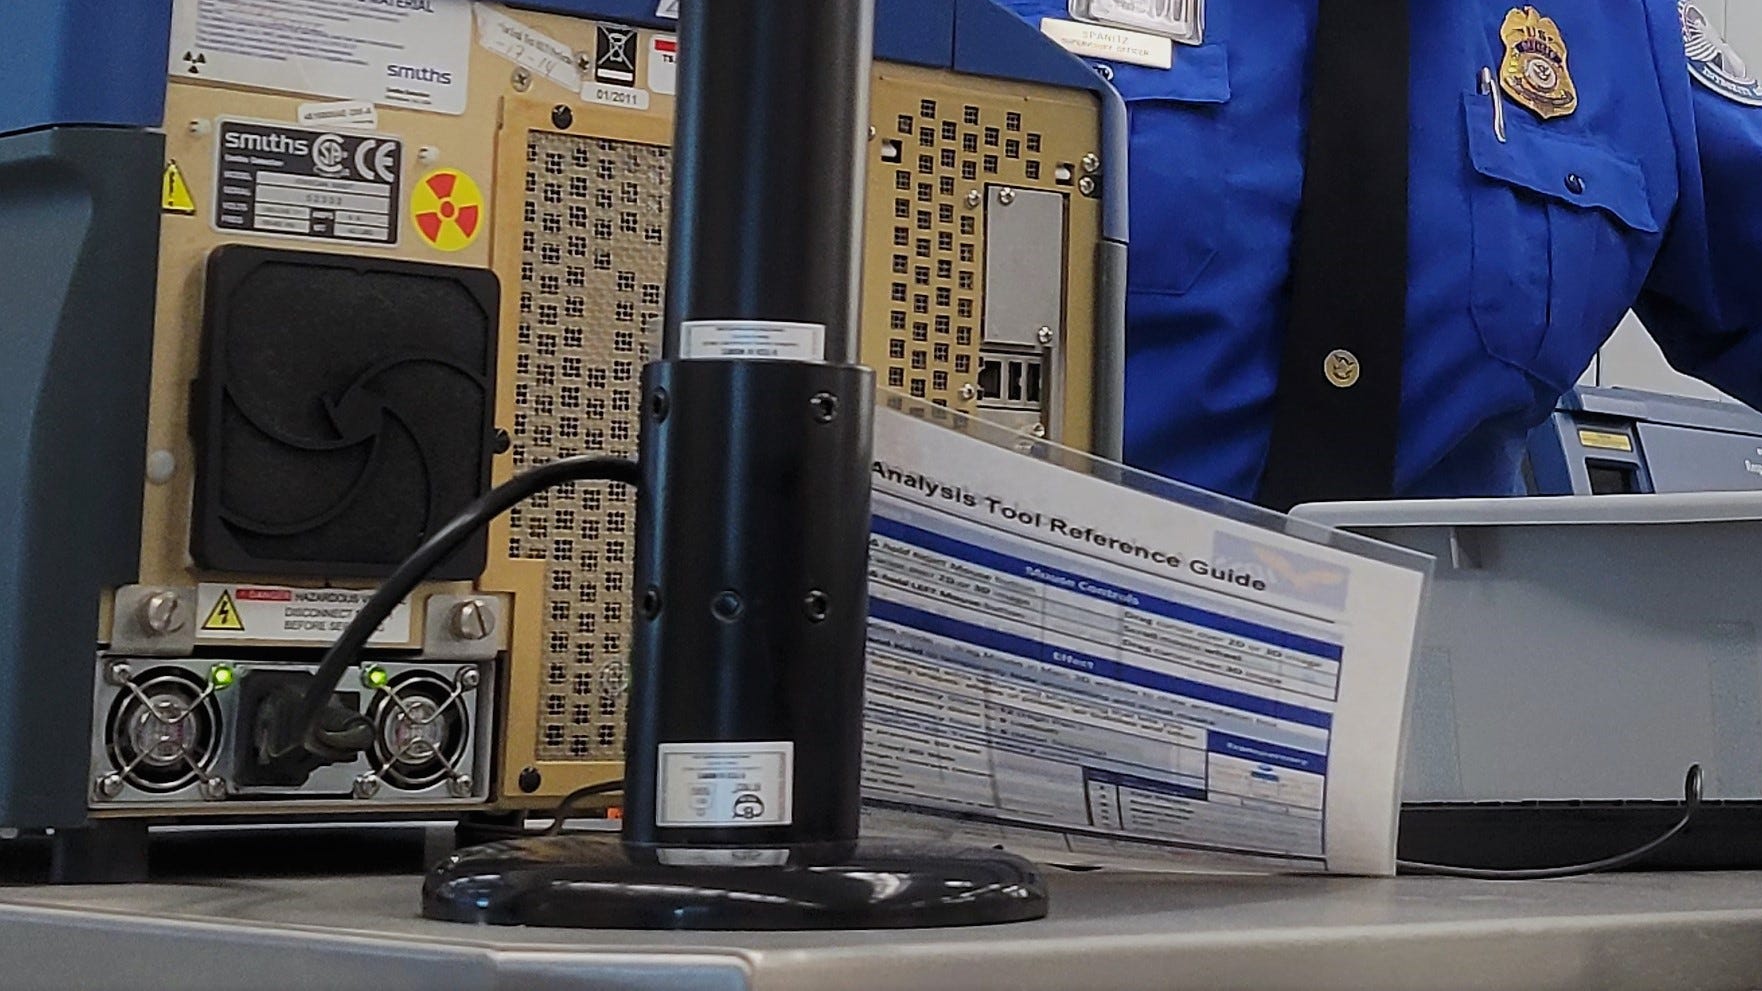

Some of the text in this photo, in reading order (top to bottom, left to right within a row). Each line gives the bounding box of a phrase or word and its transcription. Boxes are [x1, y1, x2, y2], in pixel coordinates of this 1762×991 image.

[386, 63, 452, 86] smiths
[596, 89, 638, 105] 01/2011
[225, 131, 309, 156] smiths
[872, 461, 1266, 592] Analysis Tool Reference Guide
[284, 607, 352, 619] DISCONNECT
[284, 620, 326, 631] BEFORE
